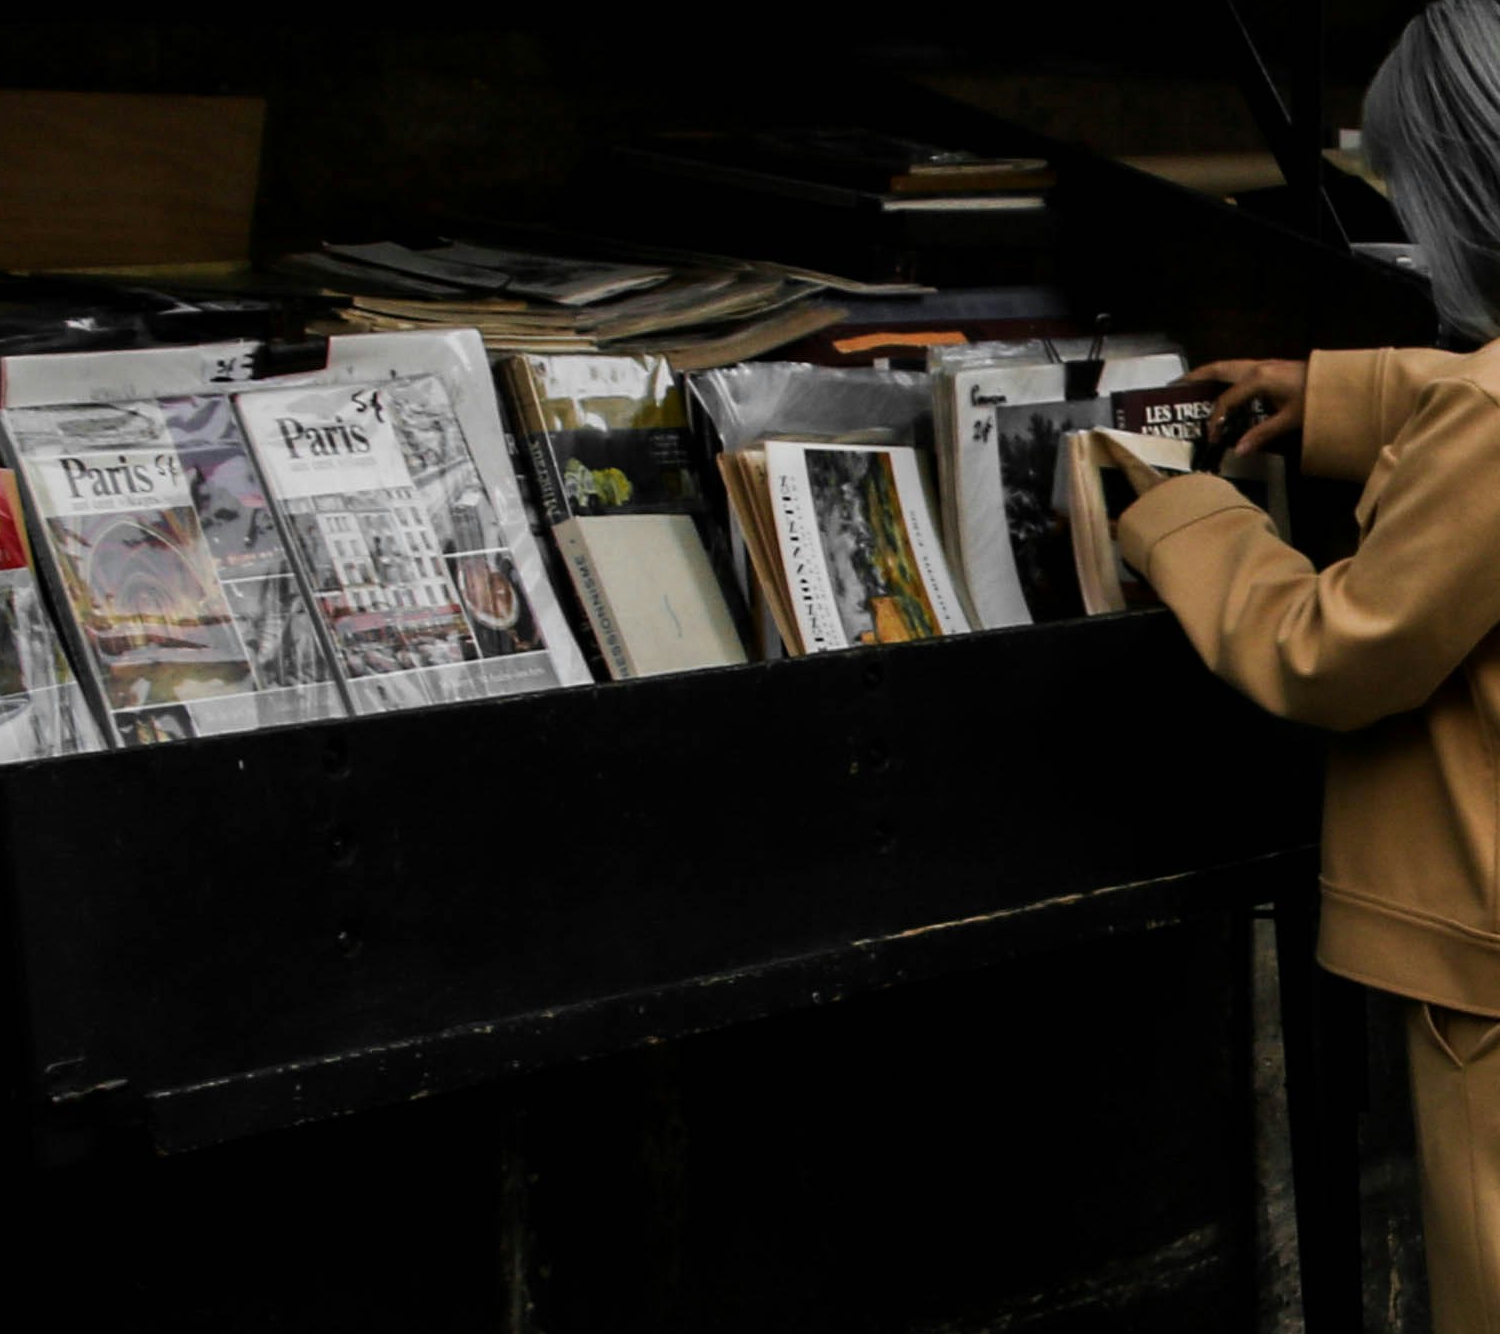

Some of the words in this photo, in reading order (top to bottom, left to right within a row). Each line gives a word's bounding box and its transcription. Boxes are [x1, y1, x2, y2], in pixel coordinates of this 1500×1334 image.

[1144, 403, 1173, 424] LES
[275, 415, 371, 459] Paris
[59, 454, 155, 498] Paris
